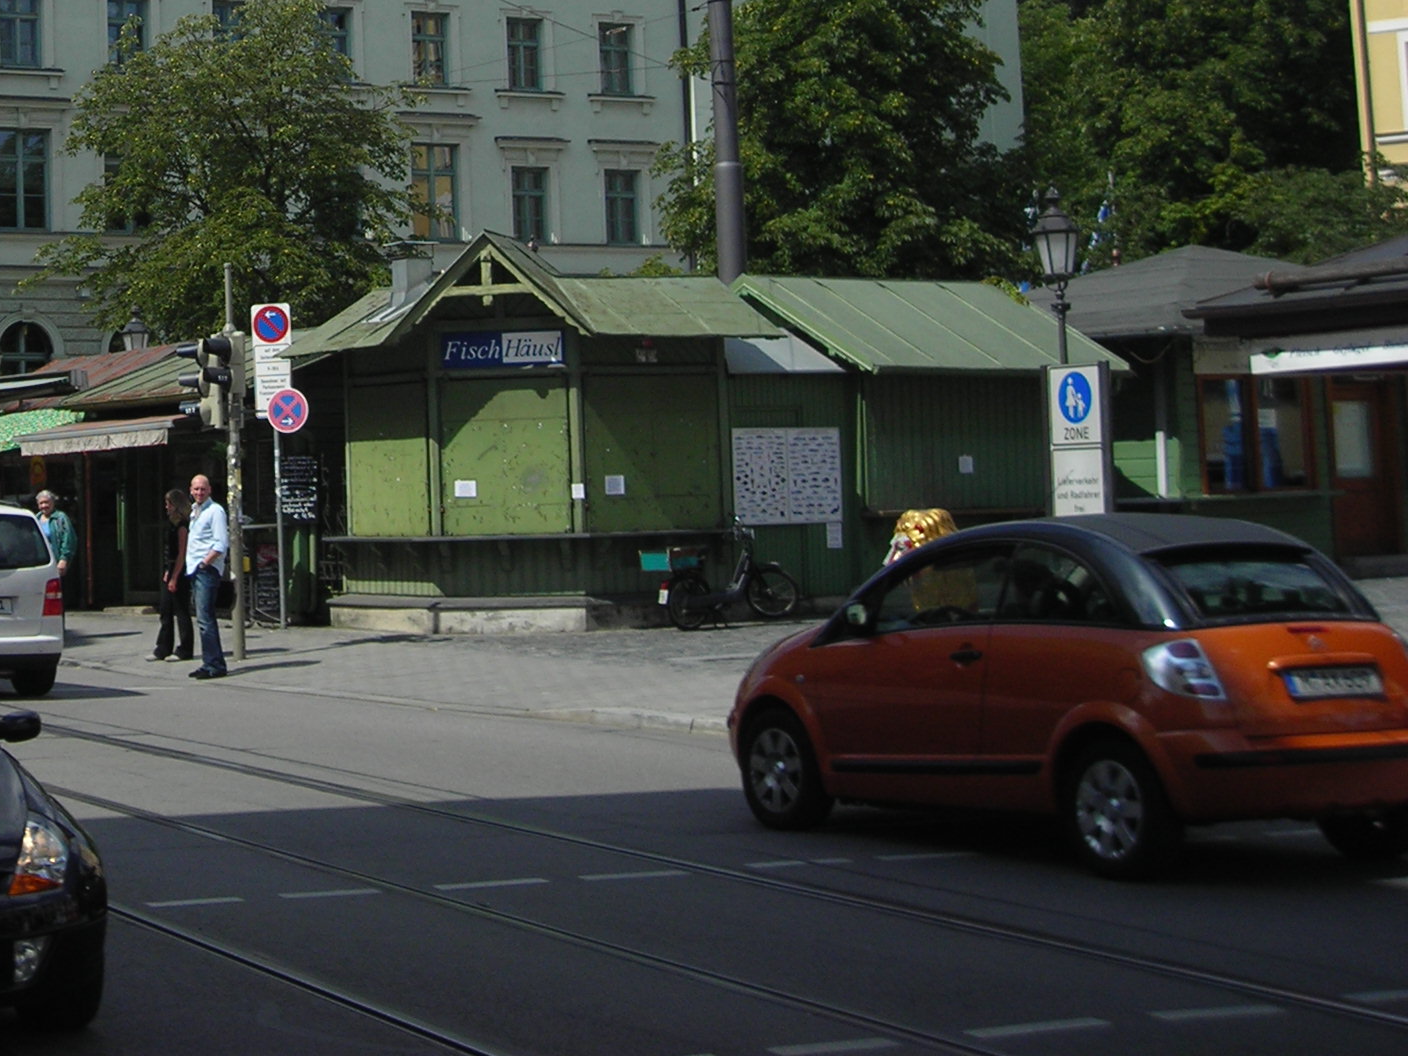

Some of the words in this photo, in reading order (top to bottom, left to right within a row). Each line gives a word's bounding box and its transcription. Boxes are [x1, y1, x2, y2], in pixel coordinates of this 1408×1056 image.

[444, 339, 500, 361] Fisch
[504, 336, 561, 358] Häusl
[1063, 426, 1090, 440] ZONE
